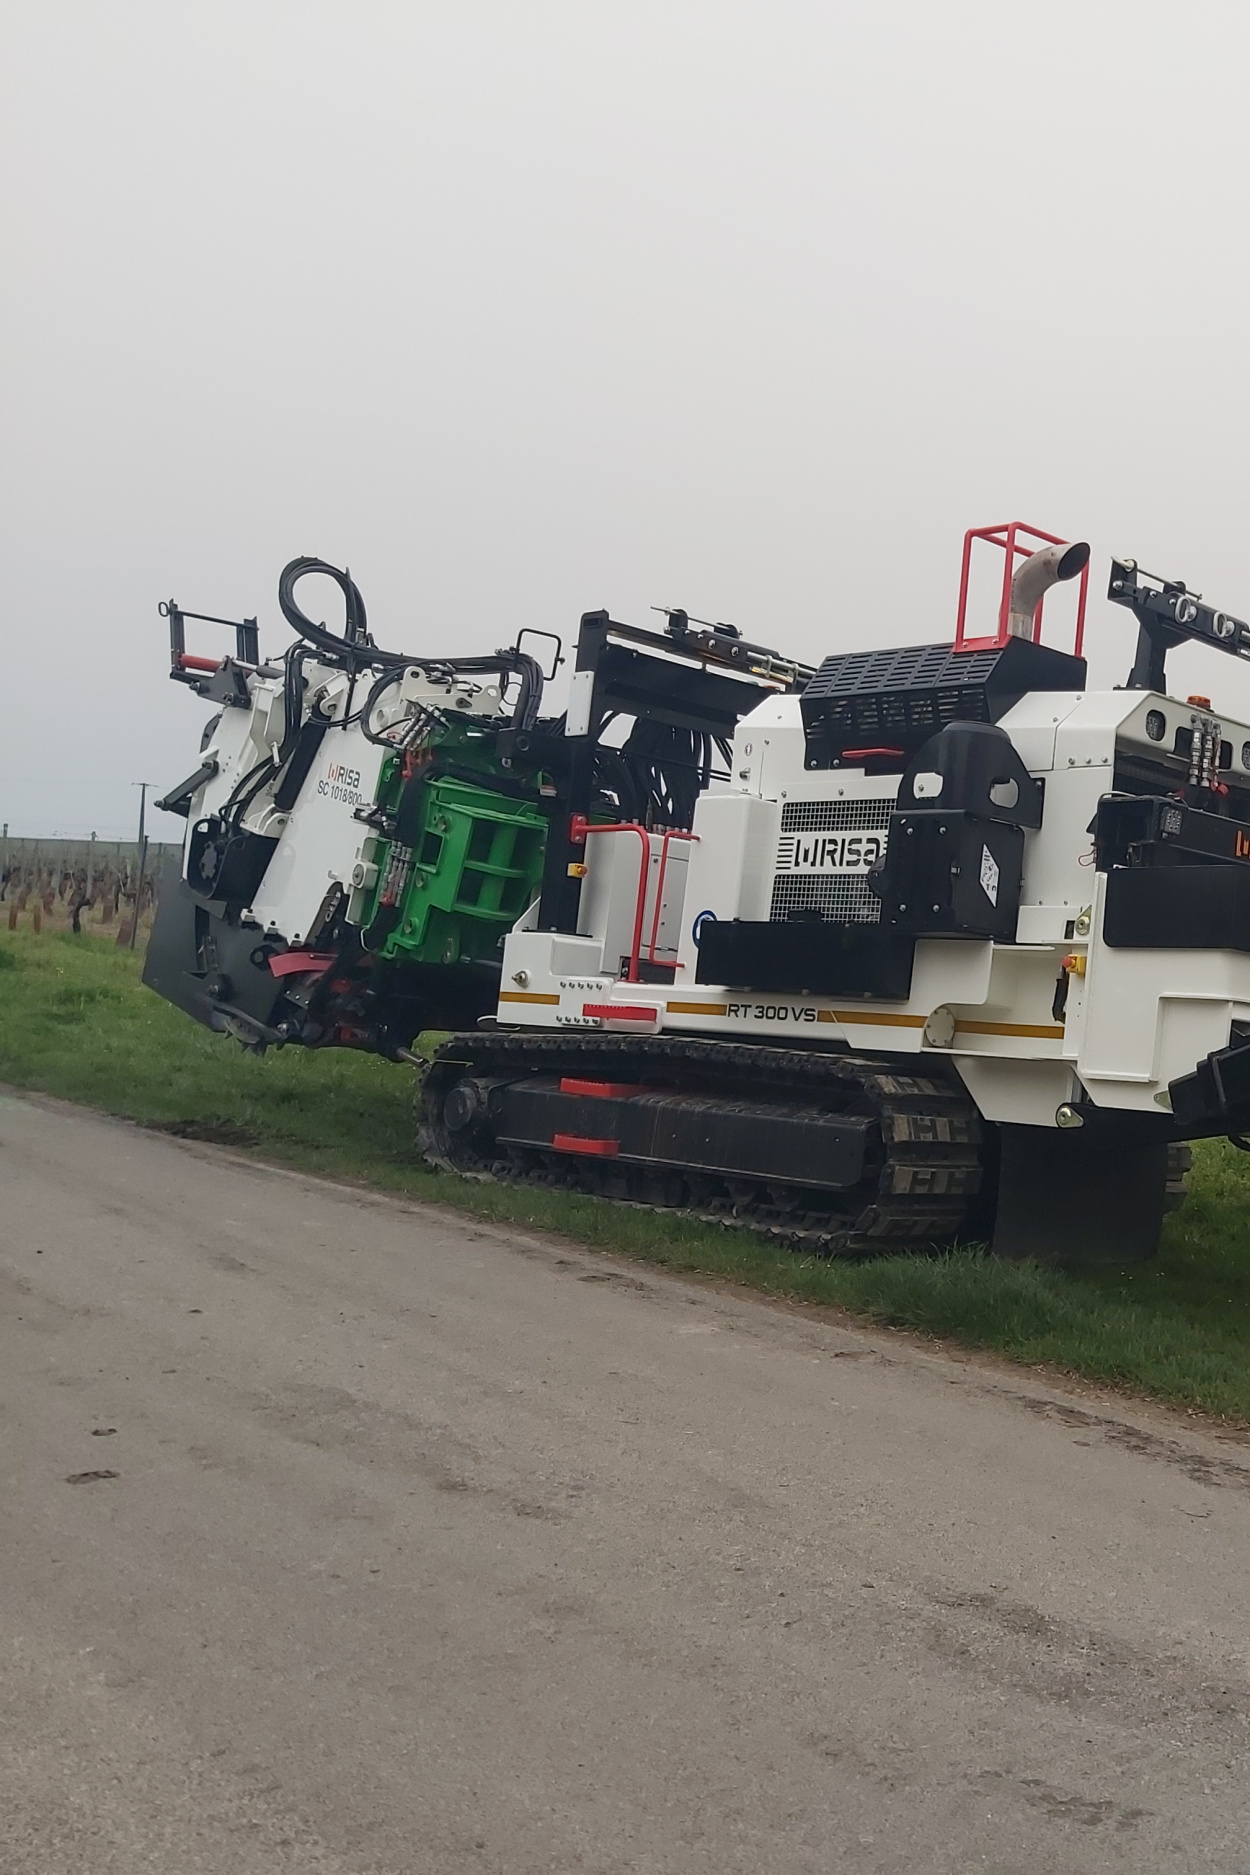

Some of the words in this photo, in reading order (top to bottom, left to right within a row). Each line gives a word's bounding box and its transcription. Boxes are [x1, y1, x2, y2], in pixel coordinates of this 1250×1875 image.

[317, 780, 330, 796] SC
[330, 784, 363, 806] 1018/800
[727, 1003, 752, 1019] RT
[753, 1005, 789, 1021] 300
[790, 1006, 817, 1023] VS
